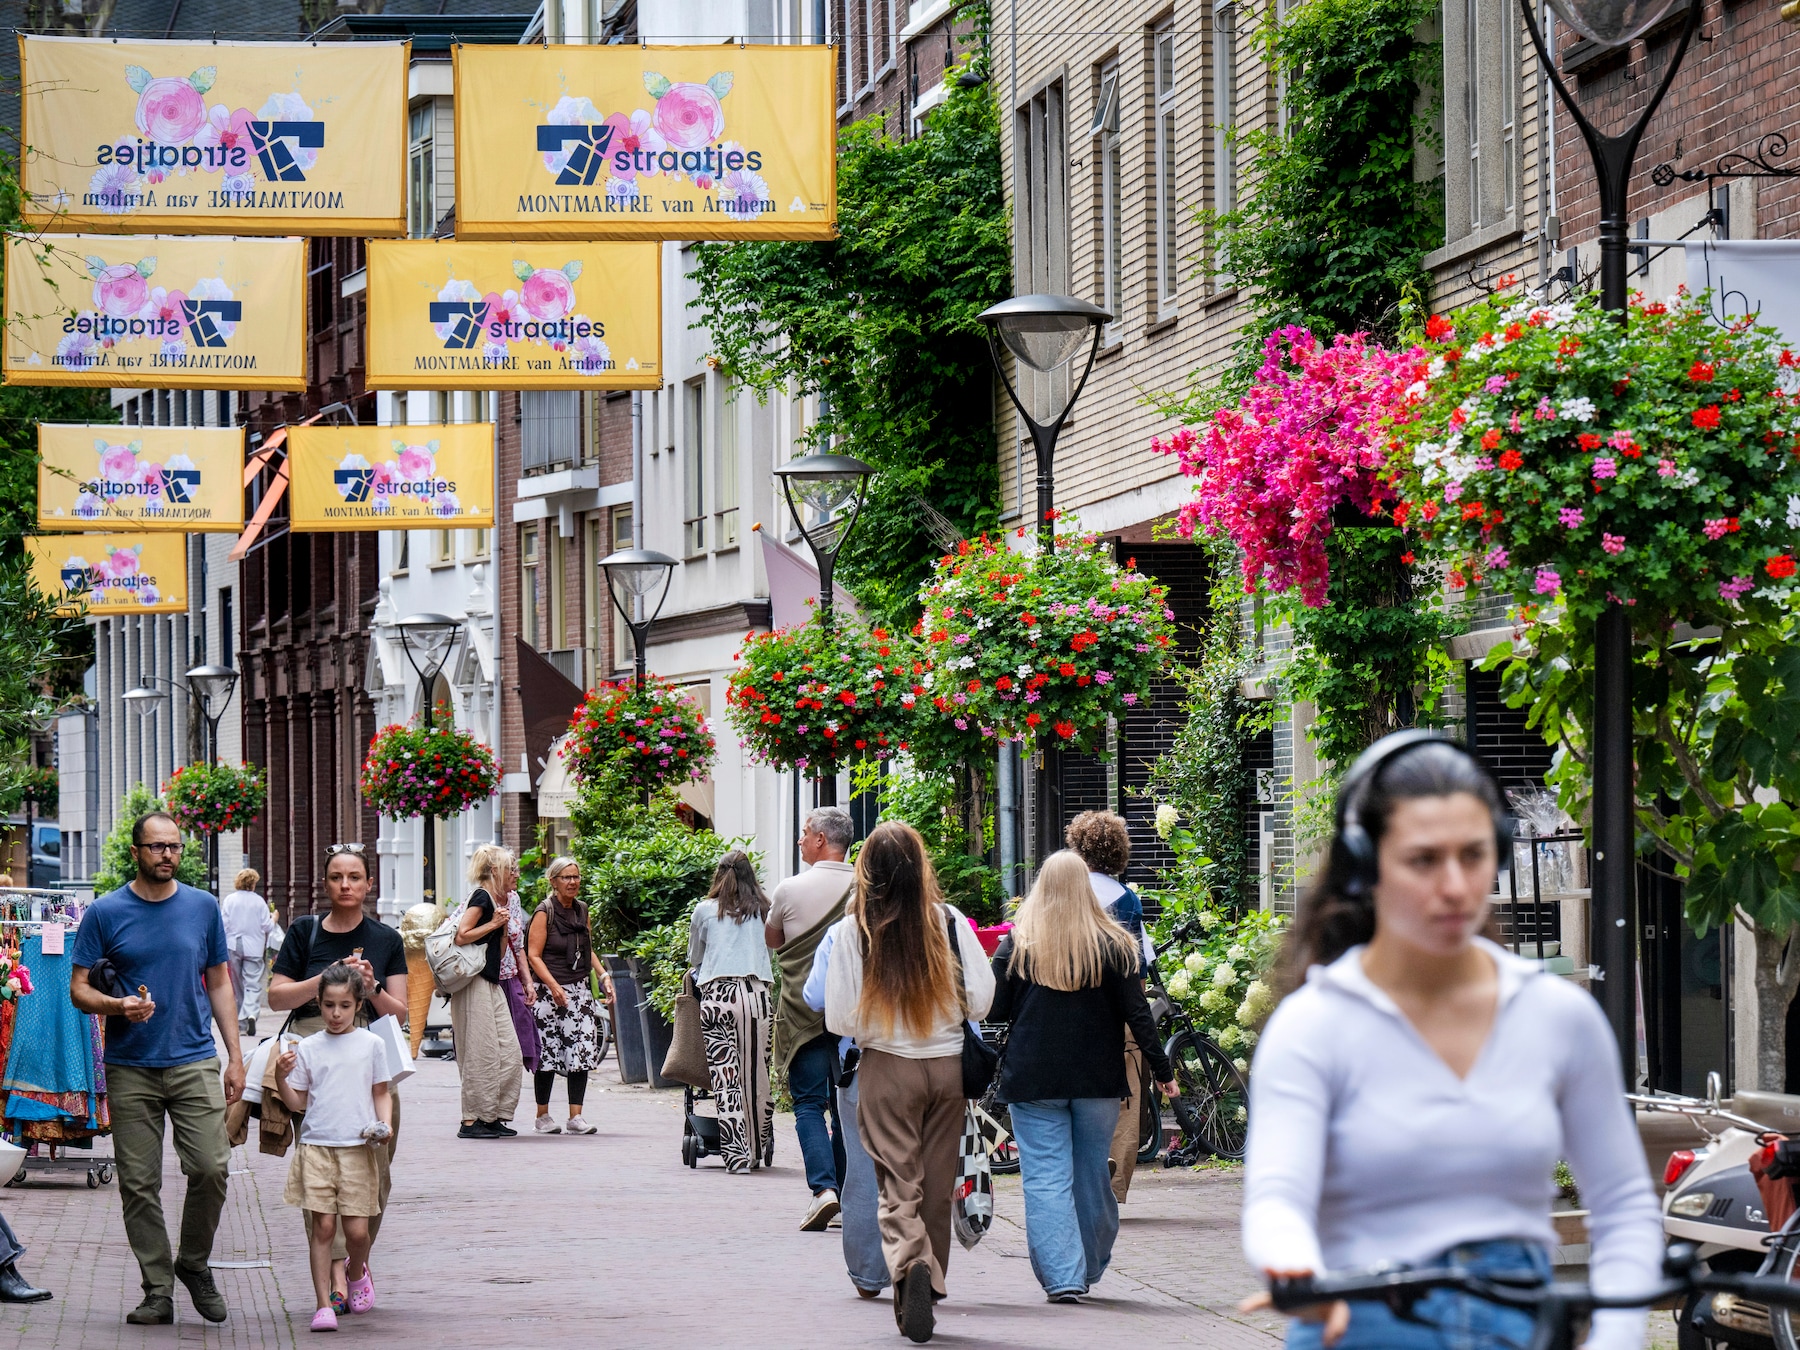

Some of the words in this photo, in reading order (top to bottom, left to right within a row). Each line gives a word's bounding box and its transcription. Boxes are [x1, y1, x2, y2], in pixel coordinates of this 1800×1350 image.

[615, 143, 762, 180] straatjes
[516, 194, 653, 213] MONTMARTRE
[662, 198, 695, 213] van
[702, 195, 777, 213] Arnhem
[490, 316, 606, 345] straatjes
[413, 355, 520, 371] MONTMARTRE
[526, 358, 552, 370] van
[558, 356, 617, 371] Arnhem
[376, 478, 457, 498] straatjes
[323, 506, 398, 518] MONTMARTRE
[402, 508, 420, 517] van
[424, 506, 464, 516] Arnhem
